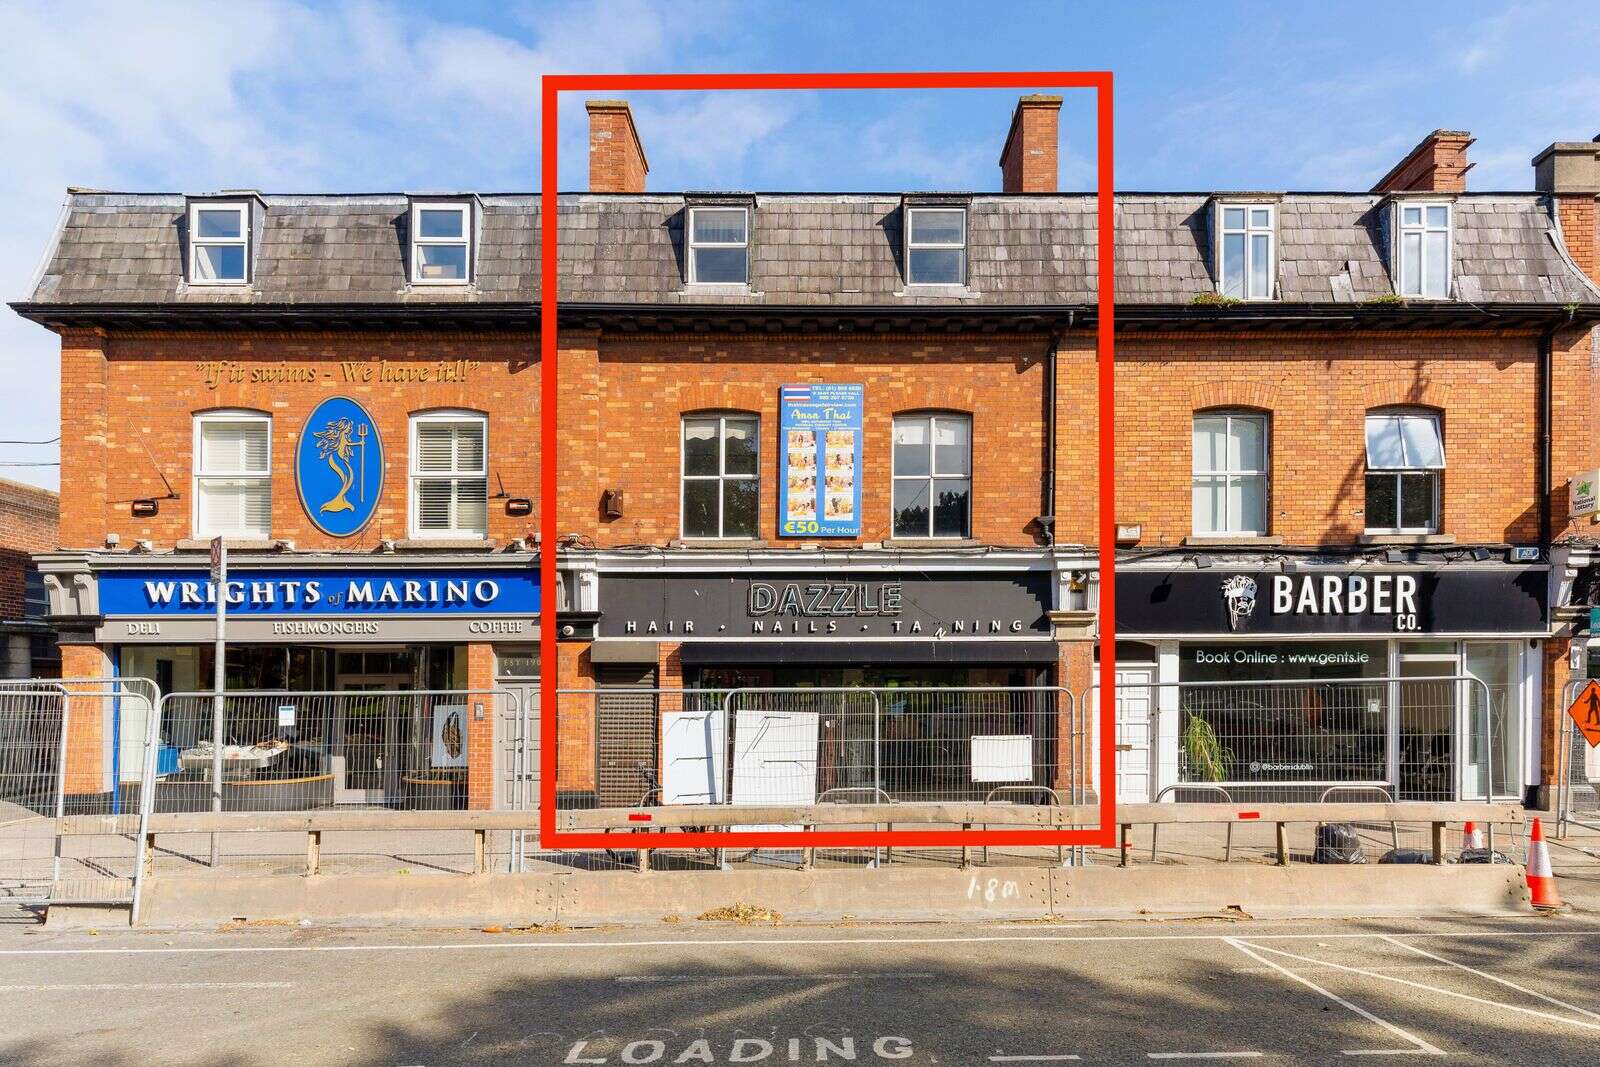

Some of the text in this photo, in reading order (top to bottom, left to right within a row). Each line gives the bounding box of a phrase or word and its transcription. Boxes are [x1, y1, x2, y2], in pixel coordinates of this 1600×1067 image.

[229, 361, 246, 383] it
[251, 361, 316, 383] swims
[340, 361, 374, 383] We
[379, 360, 430, 383] have
[1573, 496, 1596, 506] National
[1575, 502, 1595, 511] Lottery
[784, 521, 859, 534] €50 Per Hour
[144, 579, 499, 607] WRIGHTS of MARINO
[748, 581, 903, 617] DAZZLE
[1273, 575, 1417, 614] BARBER
[127, 621, 161, 636] DELI
[273, 621, 379, 635] FISHMONGERS
[468, 621, 523, 634] COFFEE
[627, 620, 695, 632] HAIR
[754, 620, 837, 632] NAILS
[1397, 613, 1422, 631] CO.
[1196, 650, 1230, 663] Book
[1234, 650, 1278, 663] Online
[1289, 650, 1369, 665] www.gents.ie
[563, 1036, 914, 1065] LOADING
